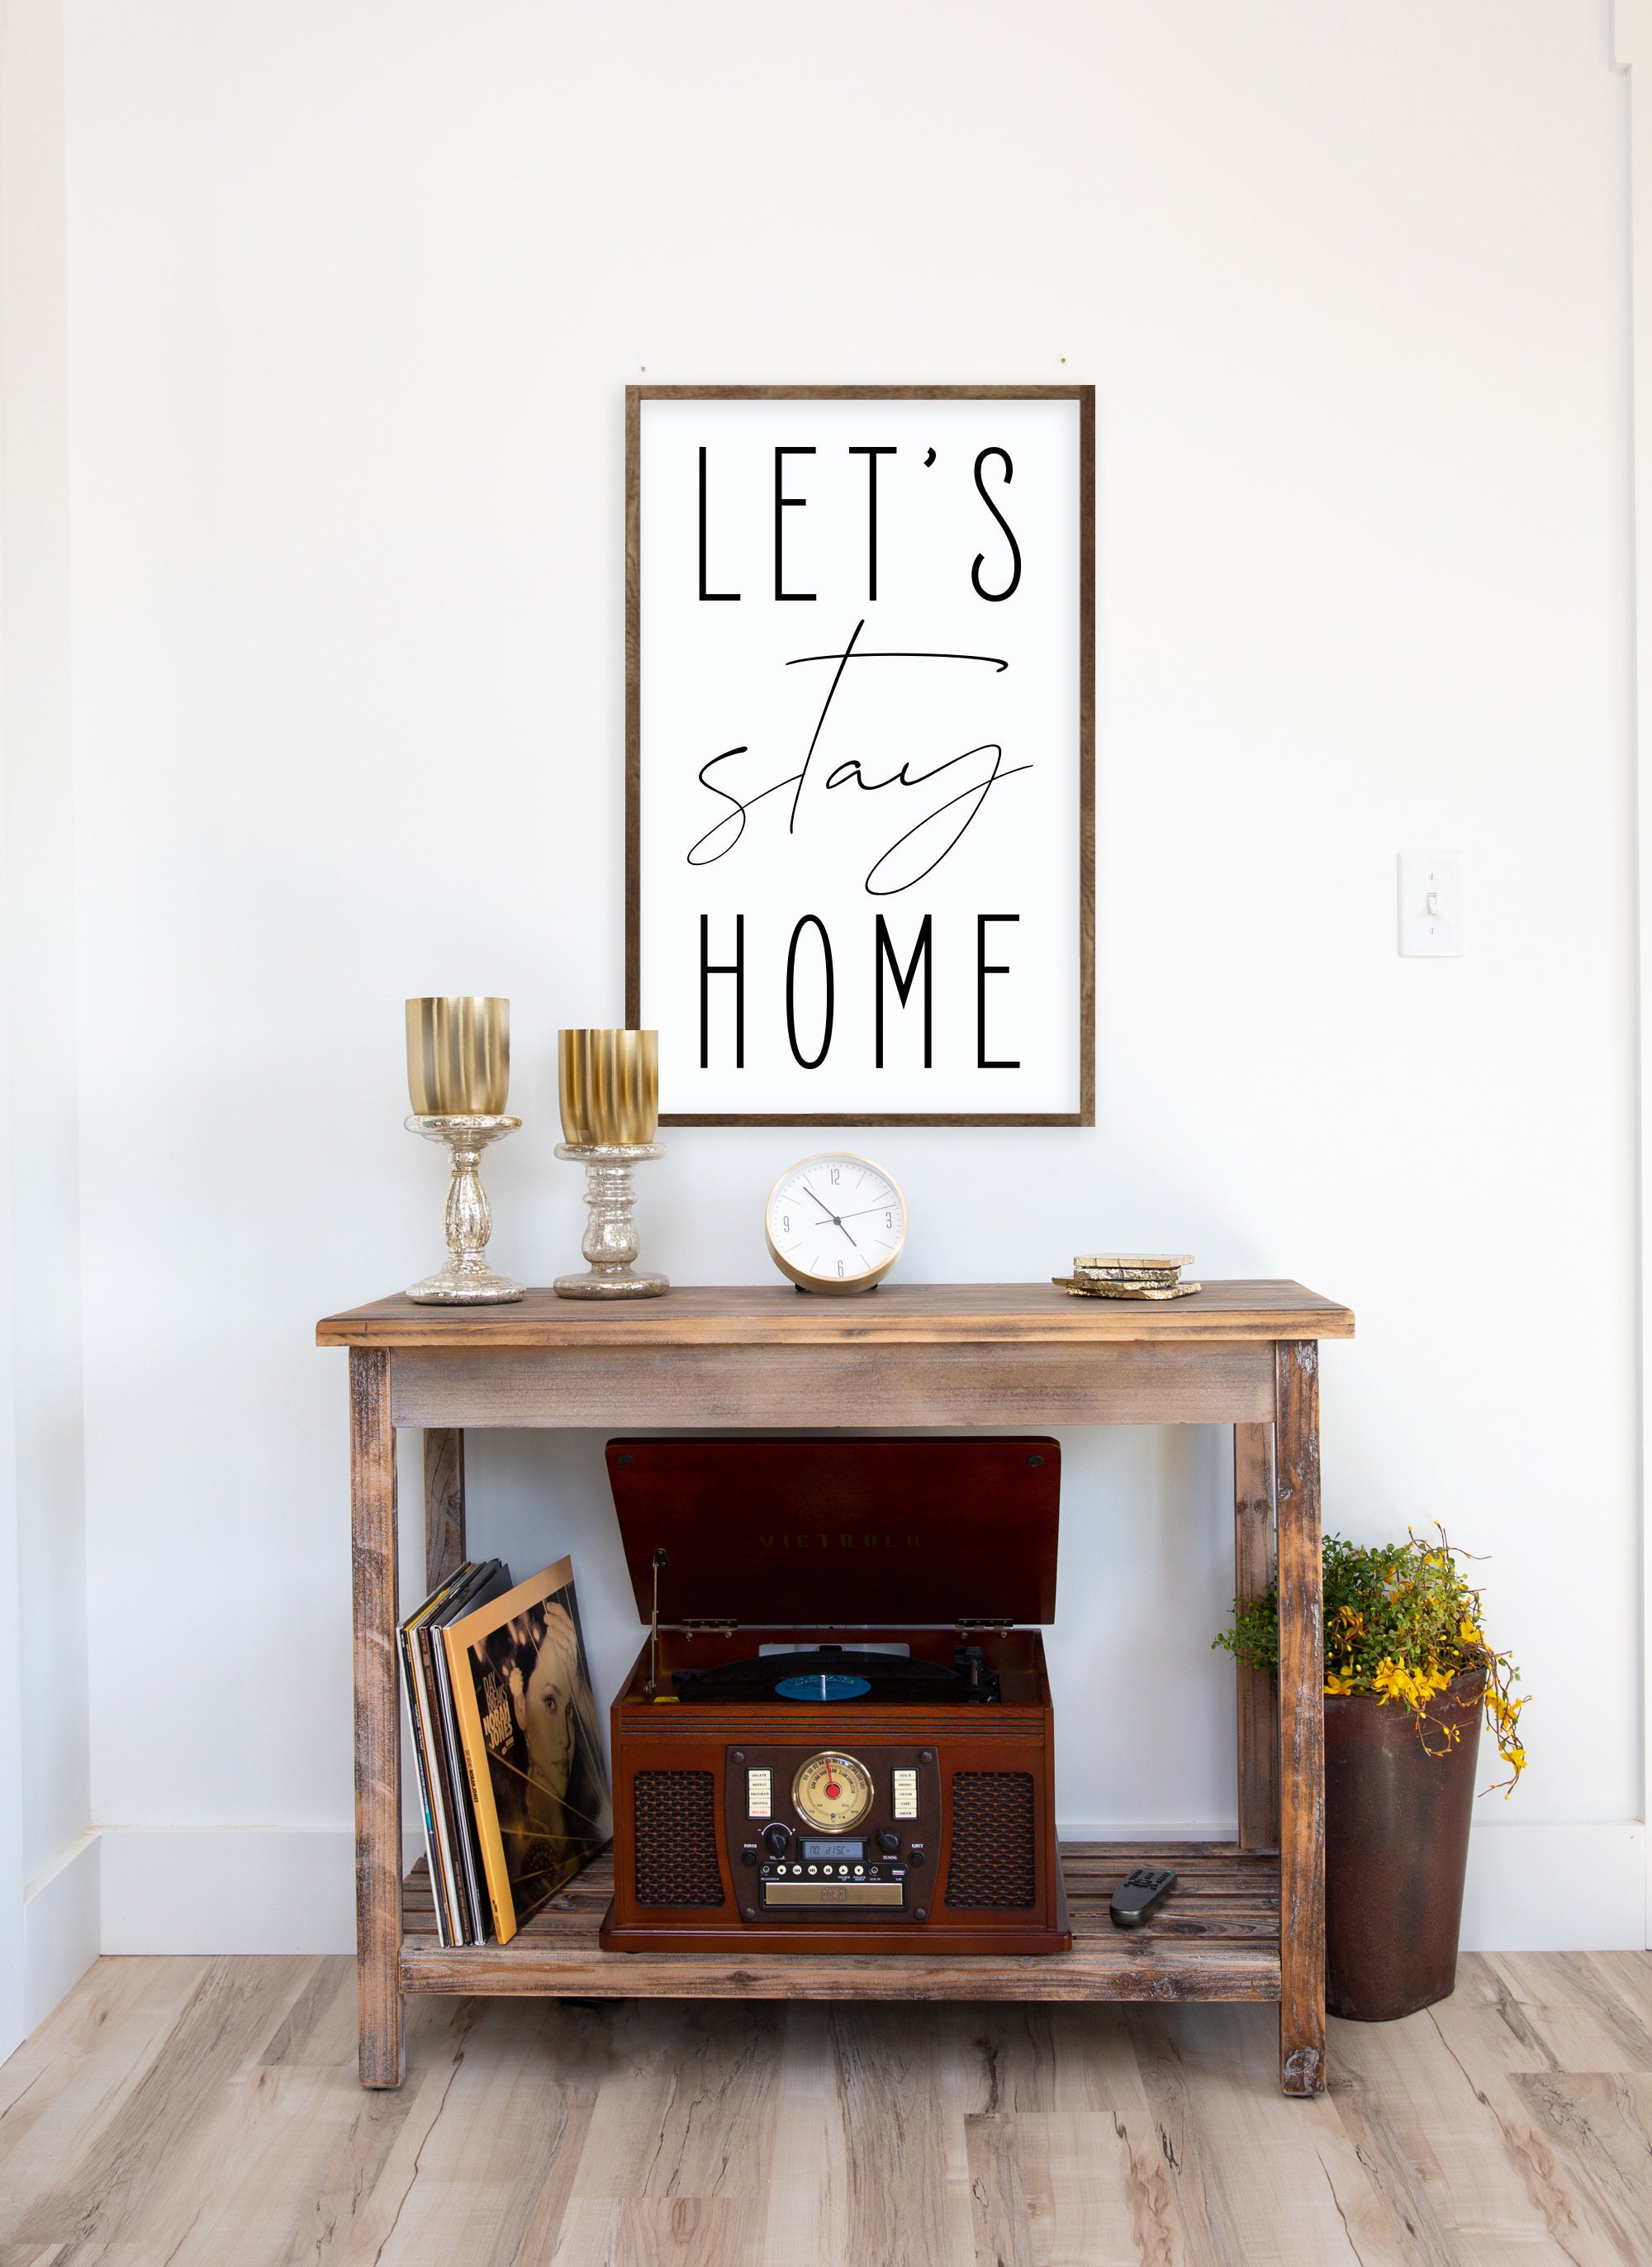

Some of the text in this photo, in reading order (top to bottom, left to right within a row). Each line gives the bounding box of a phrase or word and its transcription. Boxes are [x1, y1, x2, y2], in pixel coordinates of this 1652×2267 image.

[700, 447, 1021, 602] LET'S
[687, 620, 1034, 896] stay
[700, 915, 1021, 1069] HOME
[830, 1168, 840, 1186] 12
[783, 1215, 790, 1233] 9
[885, 1212, 892, 1229] 3
[838, 1260, 844, 1277] 6
[760, 1533, 920, 1547] VICTROLA
[482, 1670, 496, 1694] DAY
[482, 1700, 511, 1736] NORAH
[489, 1720, 513, 1750] JONES
